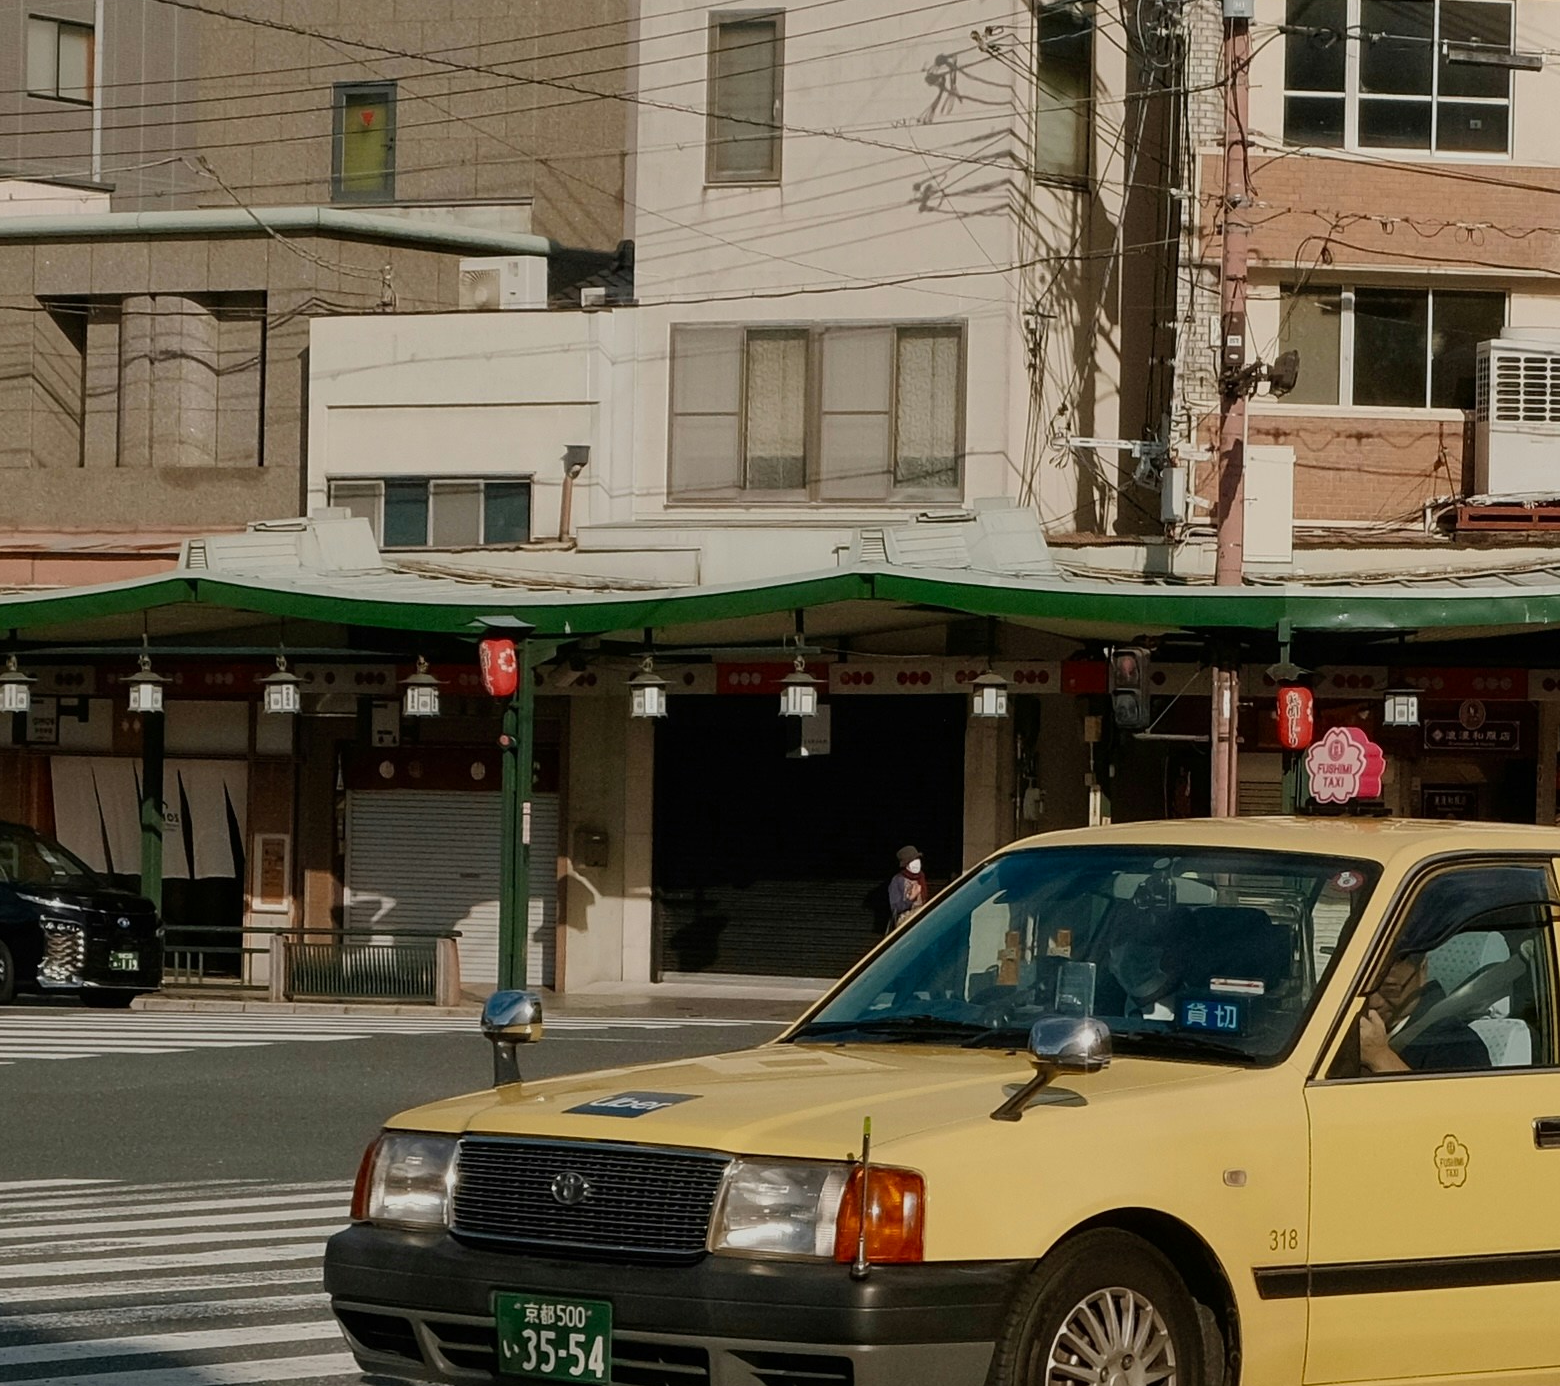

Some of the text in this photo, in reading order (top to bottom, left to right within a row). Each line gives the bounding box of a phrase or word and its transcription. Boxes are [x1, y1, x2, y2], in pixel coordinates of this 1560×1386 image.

[1317, 763, 1352, 774] FUSHIMI
[1323, 777, 1344, 788] TAXI
[1187, 1002, 1238, 1029] 貸切
[590, 1096, 672, 1110] Uber
[1269, 1229, 1298, 1251] 318
[503, 1329, 605, 1378] い 35-54
